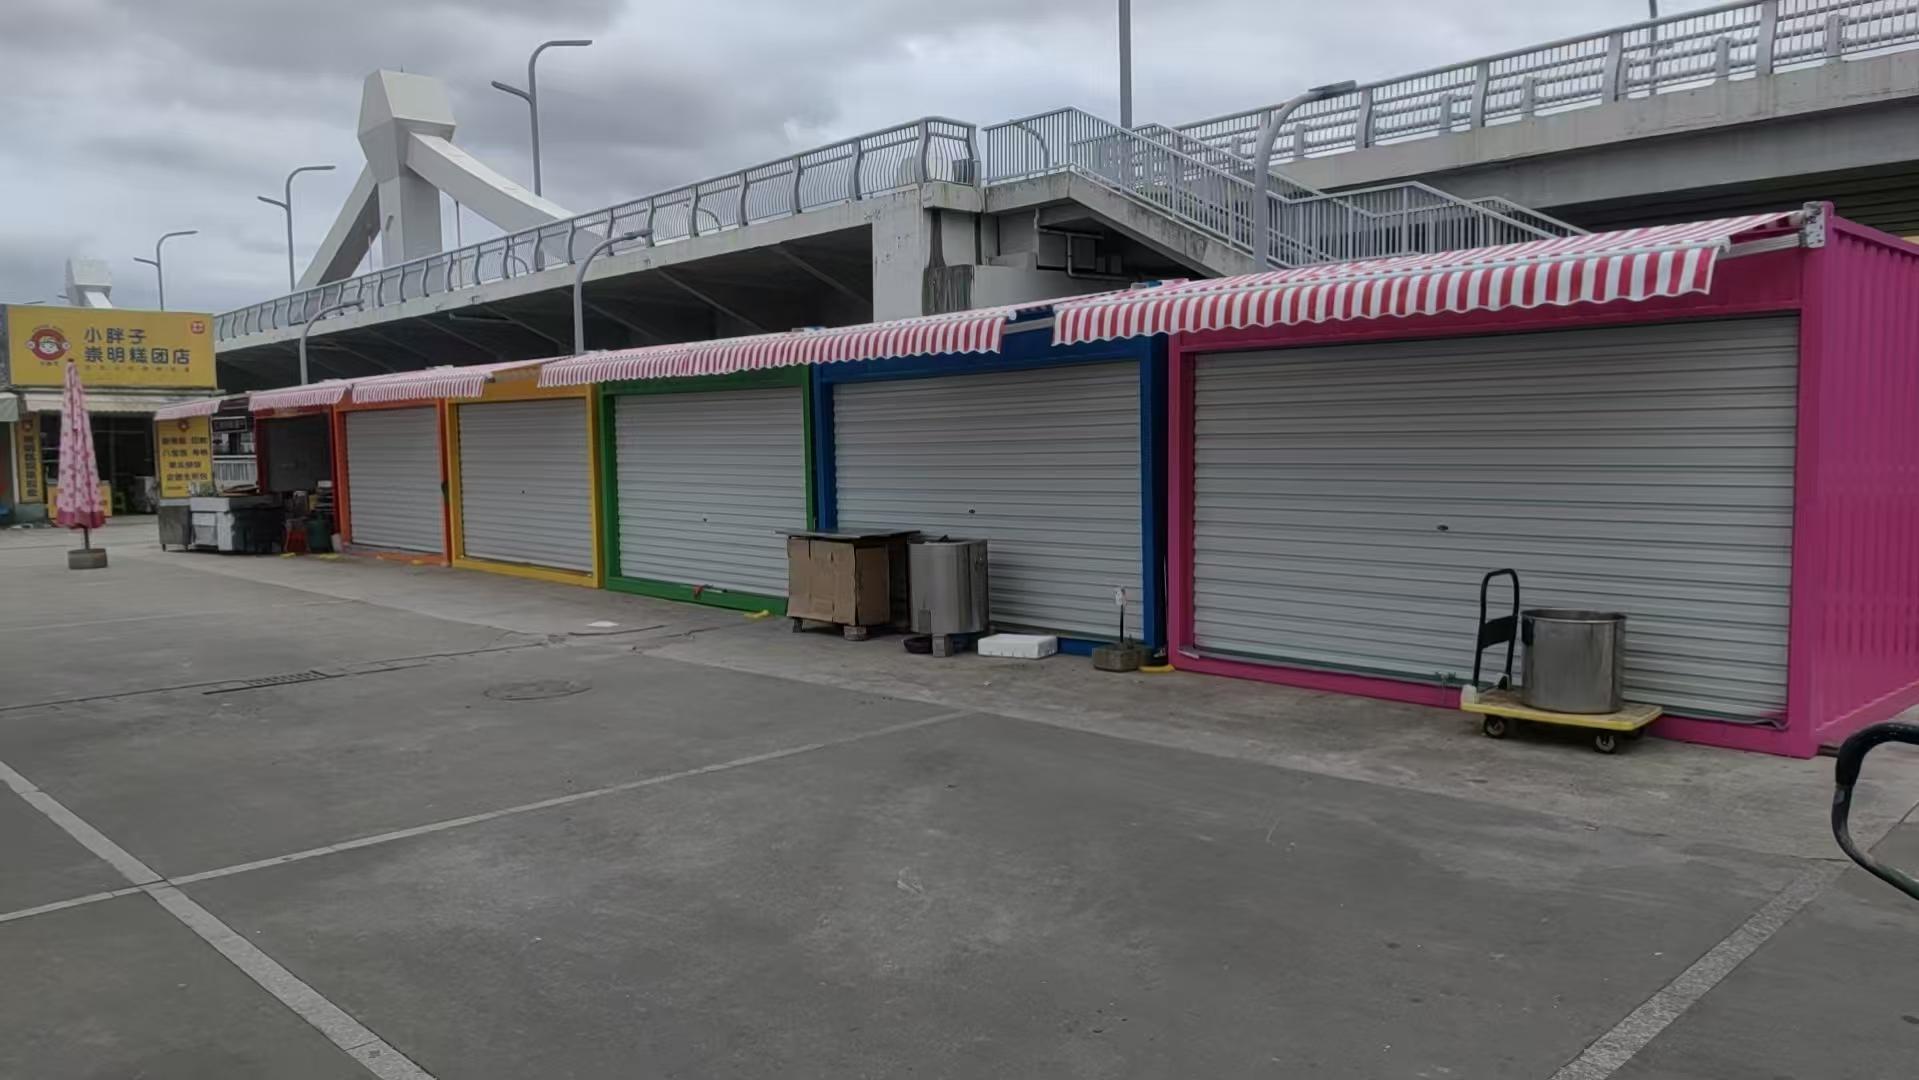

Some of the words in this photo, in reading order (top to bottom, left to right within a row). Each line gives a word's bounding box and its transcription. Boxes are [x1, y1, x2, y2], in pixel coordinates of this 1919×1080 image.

[84, 327, 147, 345] 小胖子
[84, 346, 191, 365] 崇明糕团店
